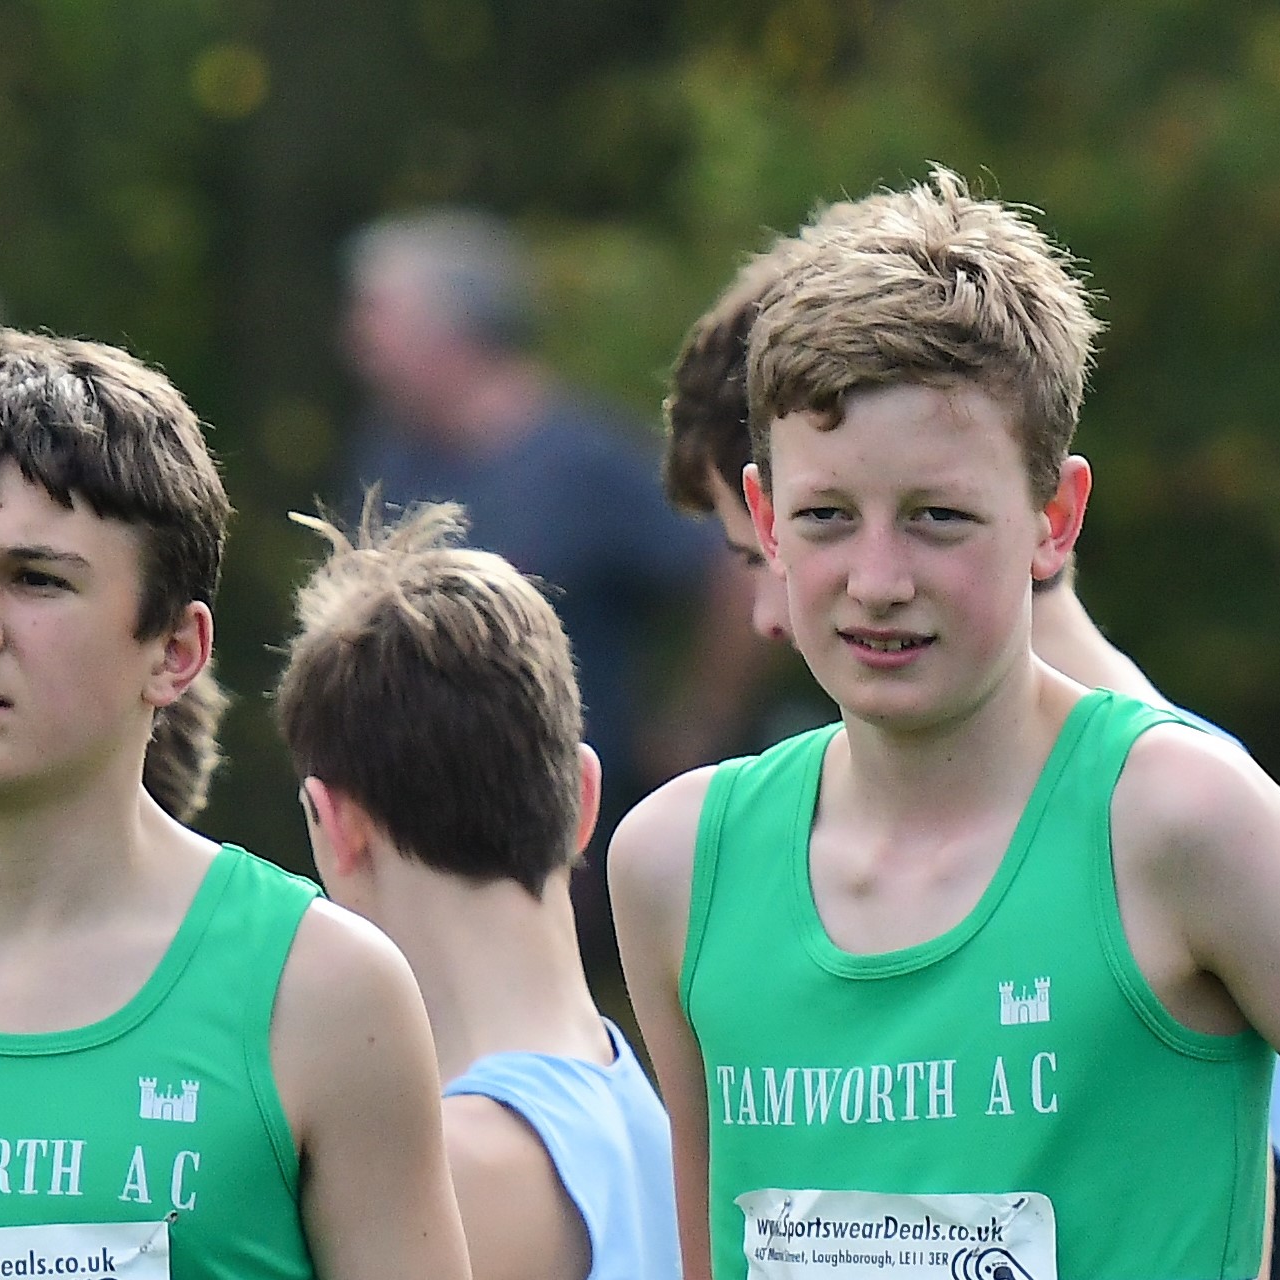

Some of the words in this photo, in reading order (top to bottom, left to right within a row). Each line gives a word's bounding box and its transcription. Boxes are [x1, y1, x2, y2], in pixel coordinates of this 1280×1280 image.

[717, 1060, 956, 1126] TAMWORTH
[985, 1056, 1015, 1115] A
[1032, 1052, 1058, 1113] C
[118, 1145, 152, 1203] A
[171, 1150, 200, 1211] C
[812, 1250, 895, 1268] Loughborough,
[928, 1252, 949, 1265] 3ER
